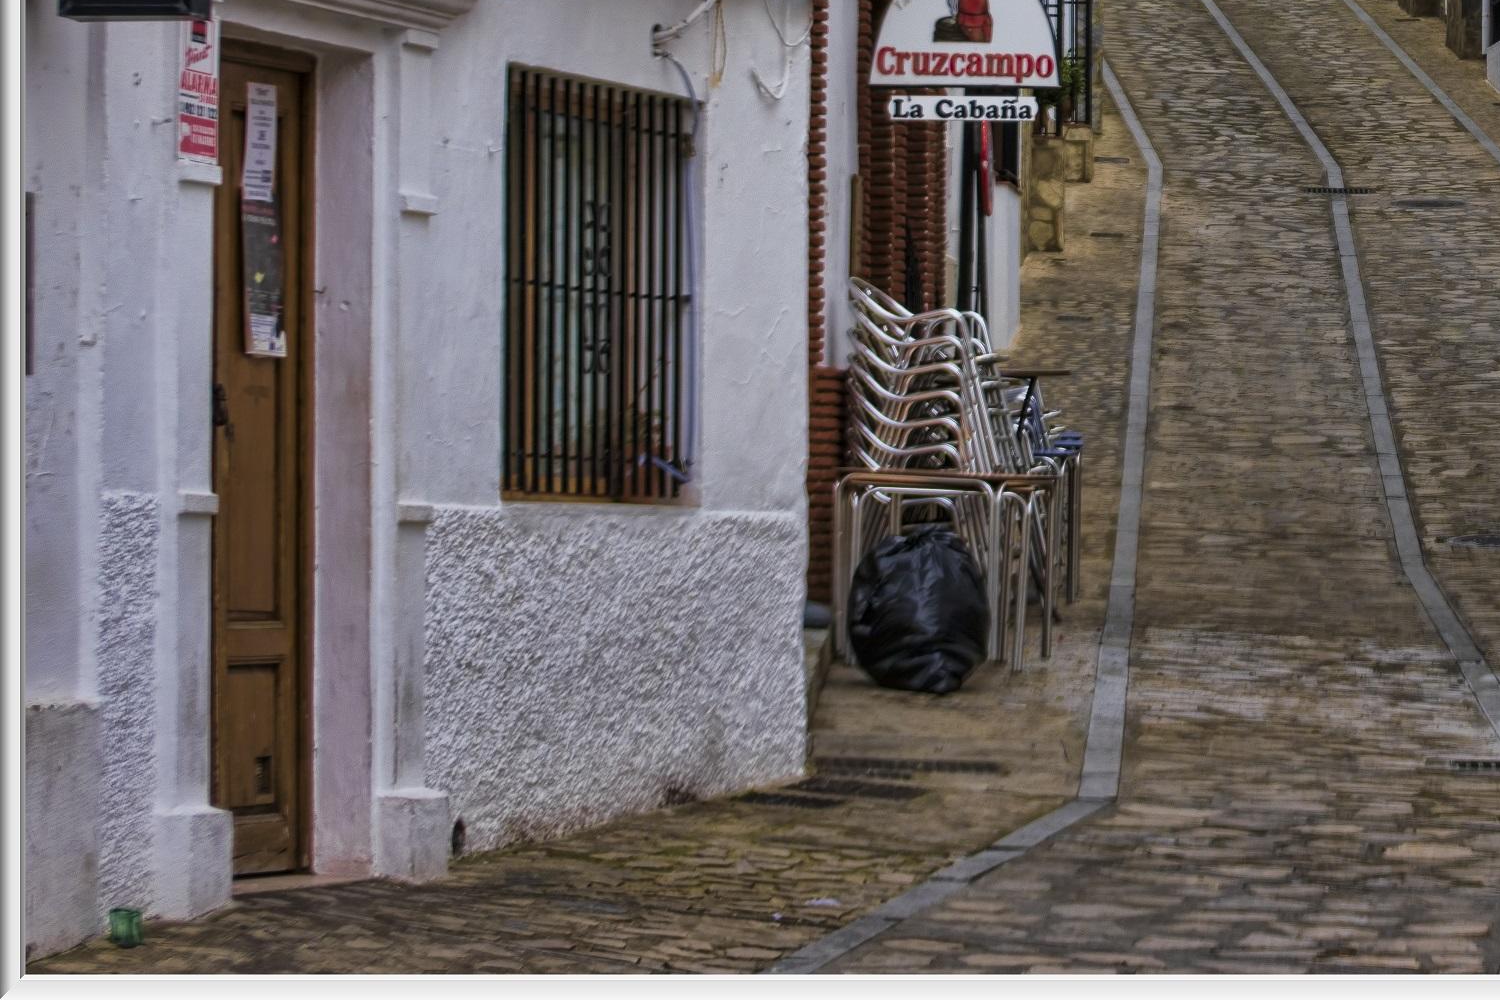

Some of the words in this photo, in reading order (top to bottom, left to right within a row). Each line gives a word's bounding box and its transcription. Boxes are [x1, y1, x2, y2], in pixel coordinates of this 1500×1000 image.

[876, 46, 1055, 83] Cruzcampo
[892, 99, 924, 118] La
[935, 99, 1033, 119] Cabaña
